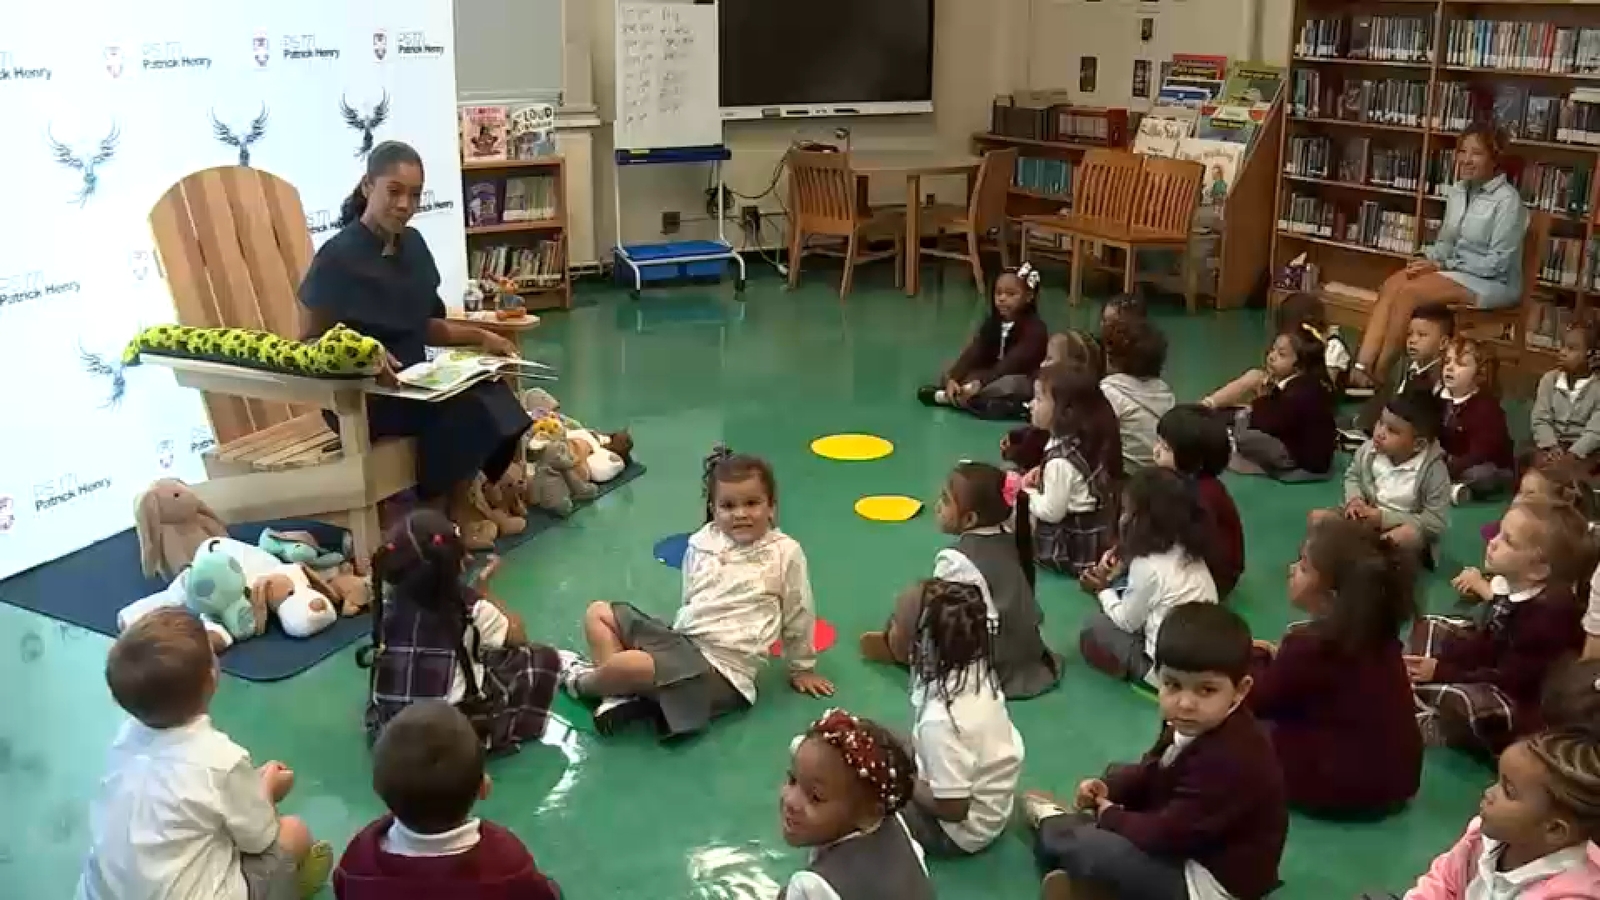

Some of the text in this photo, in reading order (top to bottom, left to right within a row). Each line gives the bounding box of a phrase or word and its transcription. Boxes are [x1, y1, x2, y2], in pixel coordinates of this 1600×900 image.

[282, 47, 341, 60] Patrick Henry
[397, 44, 445, 56] Patrick Henry
[142, 56, 213, 70] Patrick Henry
[13, 66, 52, 81] Henry
[433, 200, 454, 210] Henry
[0, 281, 81, 306] Patrick Henry
[34, 477, 112, 512] Patrick Henry
